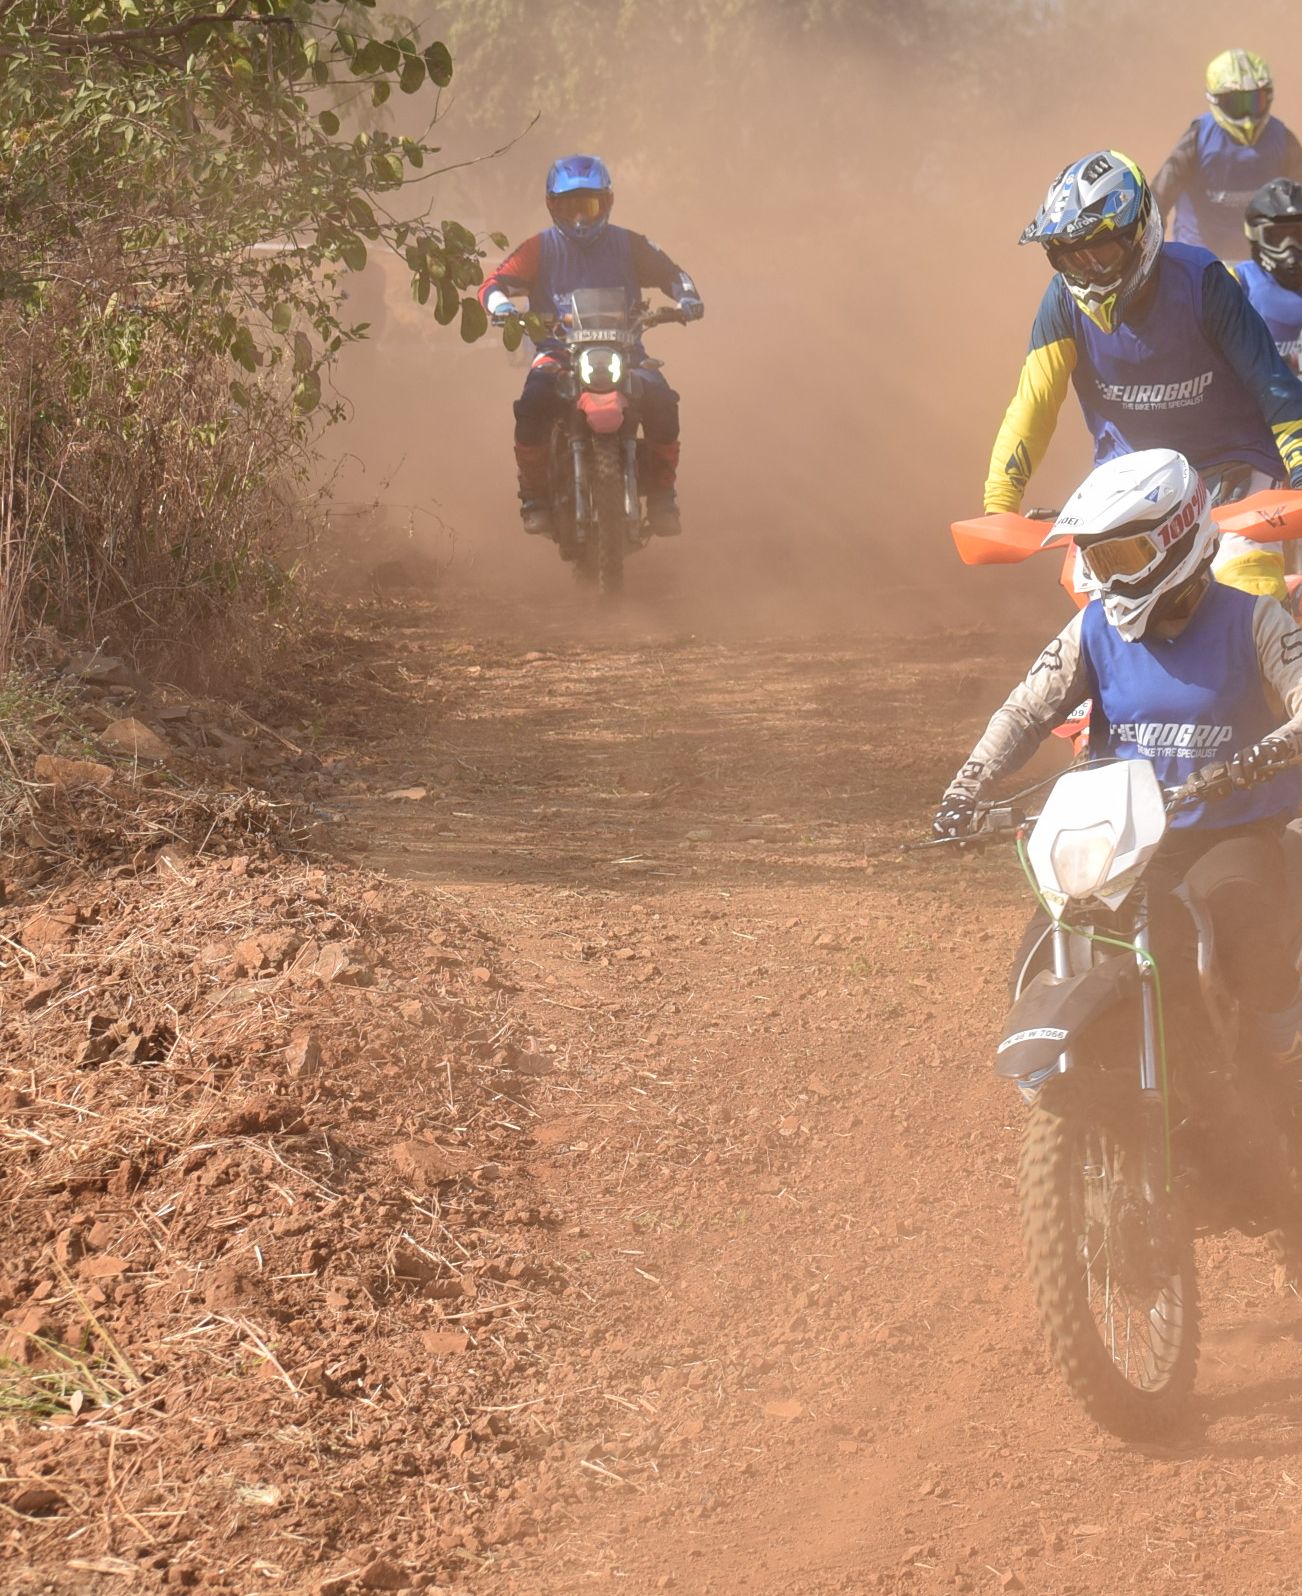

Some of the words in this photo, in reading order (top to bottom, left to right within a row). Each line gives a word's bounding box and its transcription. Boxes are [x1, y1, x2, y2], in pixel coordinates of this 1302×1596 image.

[1108, 371, 1213, 403] EUROGRIP
[1122, 402, 1134, 411] THE
[1135, 403, 1150, 411] BIKE
[1151, 402, 1167, 411] TYRE
[1168, 395, 1204, 409] SPECIALIST
[1157, 477, 1208, 546] 100%
[1058, 517, 1080, 526] OEI
[1157, 747, 1177, 759] TYRE
[1177, 747, 1218, 759] SPECIALIST
